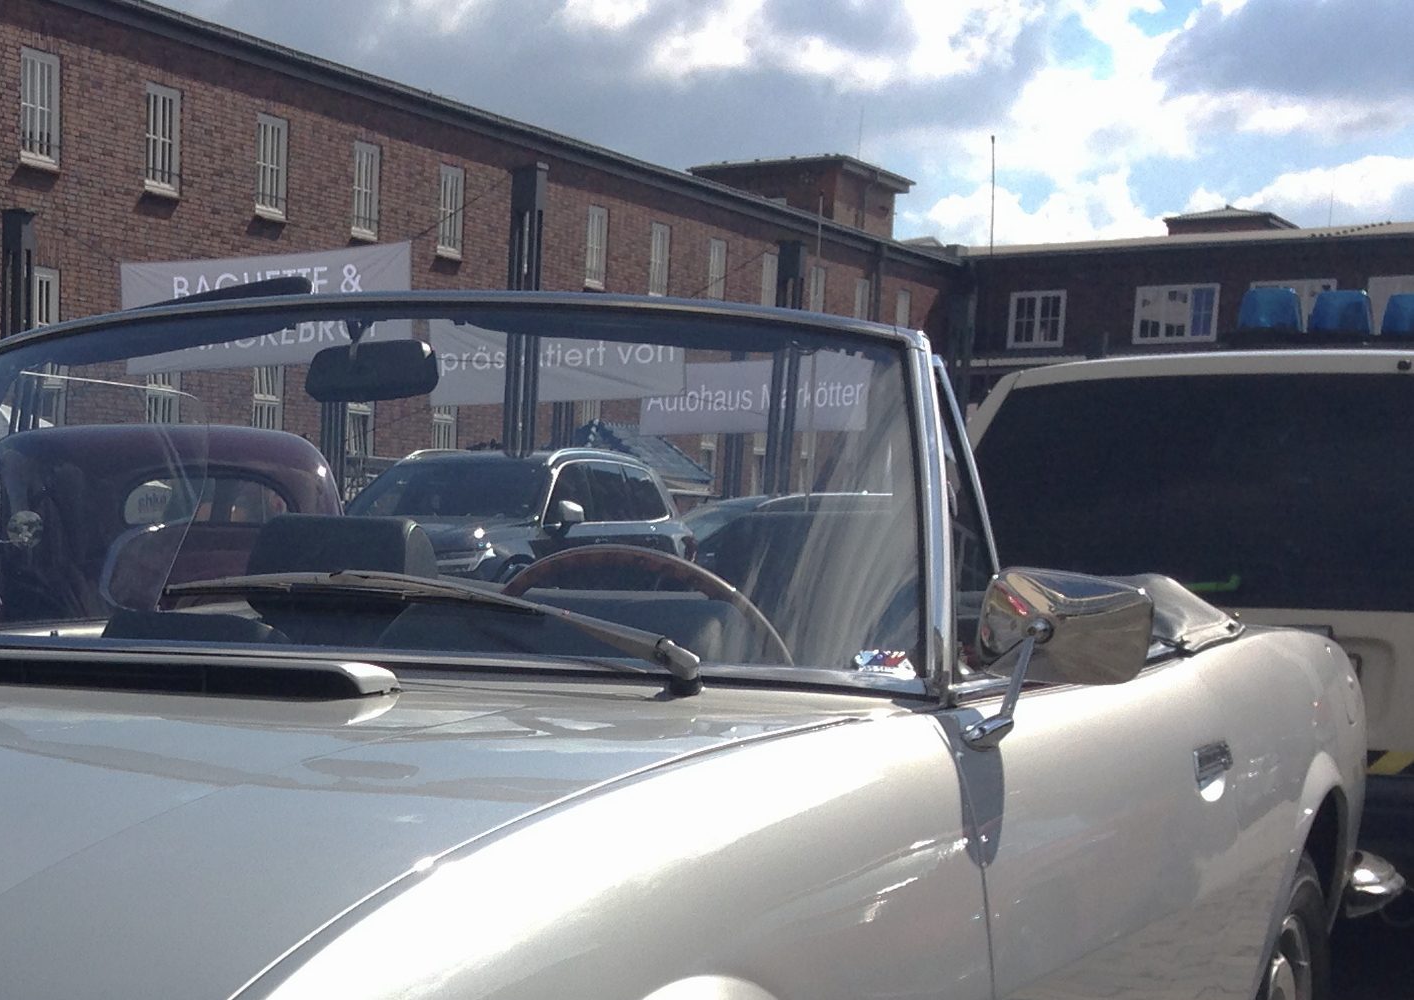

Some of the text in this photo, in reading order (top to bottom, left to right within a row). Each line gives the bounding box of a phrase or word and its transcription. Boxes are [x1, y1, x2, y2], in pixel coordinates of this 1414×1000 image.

[340, 264, 362, 292] &
[440, 340, 674, 377] prästiert von
[647, 382, 864, 412] Autohaus Mrkötter
